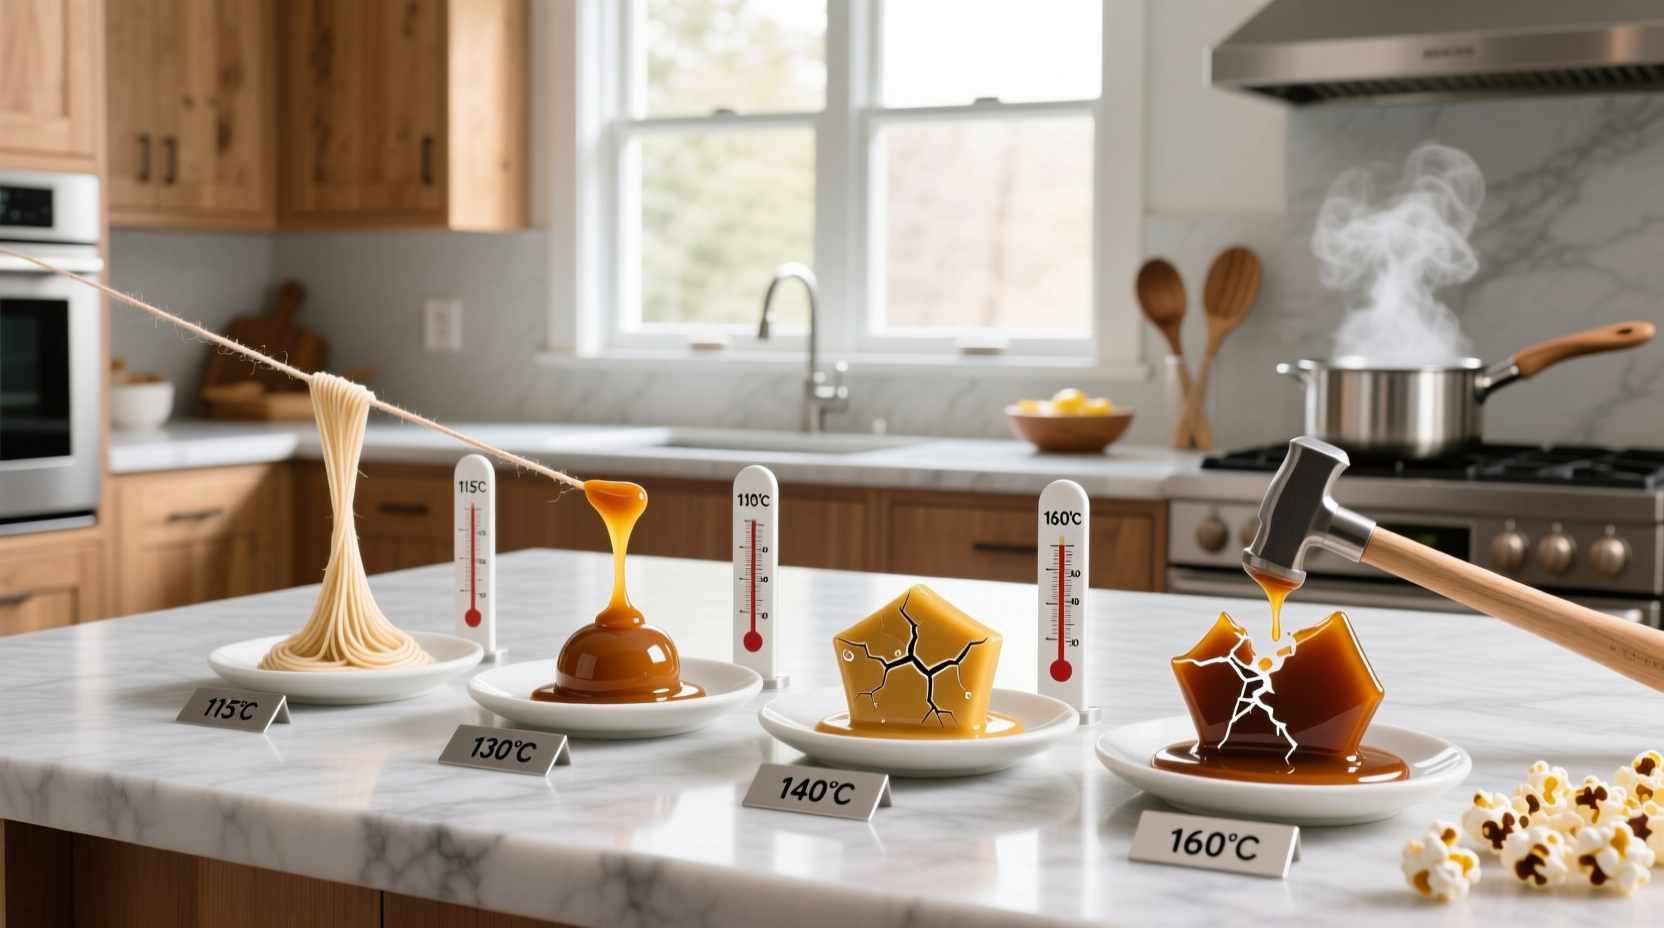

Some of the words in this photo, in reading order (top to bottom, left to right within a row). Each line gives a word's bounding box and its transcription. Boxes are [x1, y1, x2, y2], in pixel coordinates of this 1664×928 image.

[203, 697, 258, 721] 115°C
[471, 736, 537, 763] 130°C
[780, 776, 855, 806] 140°C
[1171, 828, 1260, 861] 160°C
